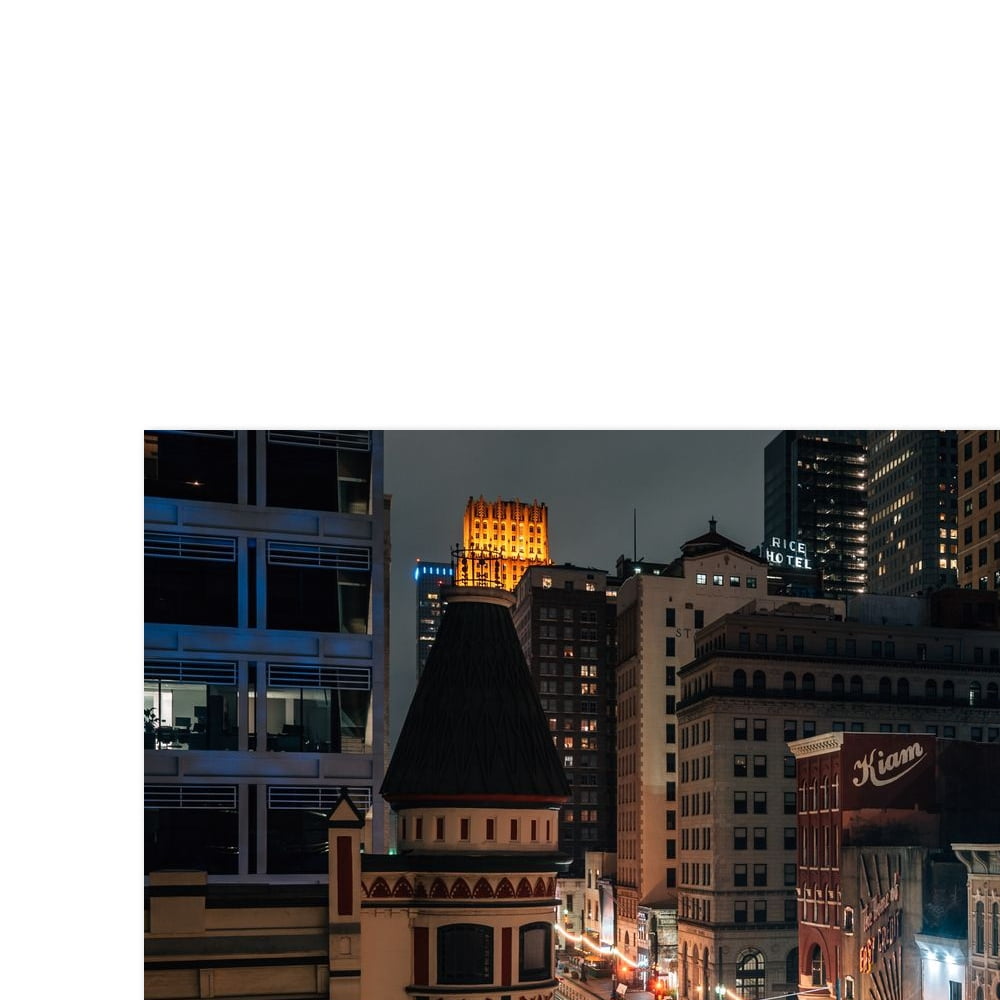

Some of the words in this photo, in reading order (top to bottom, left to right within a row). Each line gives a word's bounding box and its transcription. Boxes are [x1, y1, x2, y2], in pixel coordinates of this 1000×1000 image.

[772, 536, 806, 554] RICE
[766, 549, 812, 570] HOTEL
[852, 742, 928, 787] Kiam
